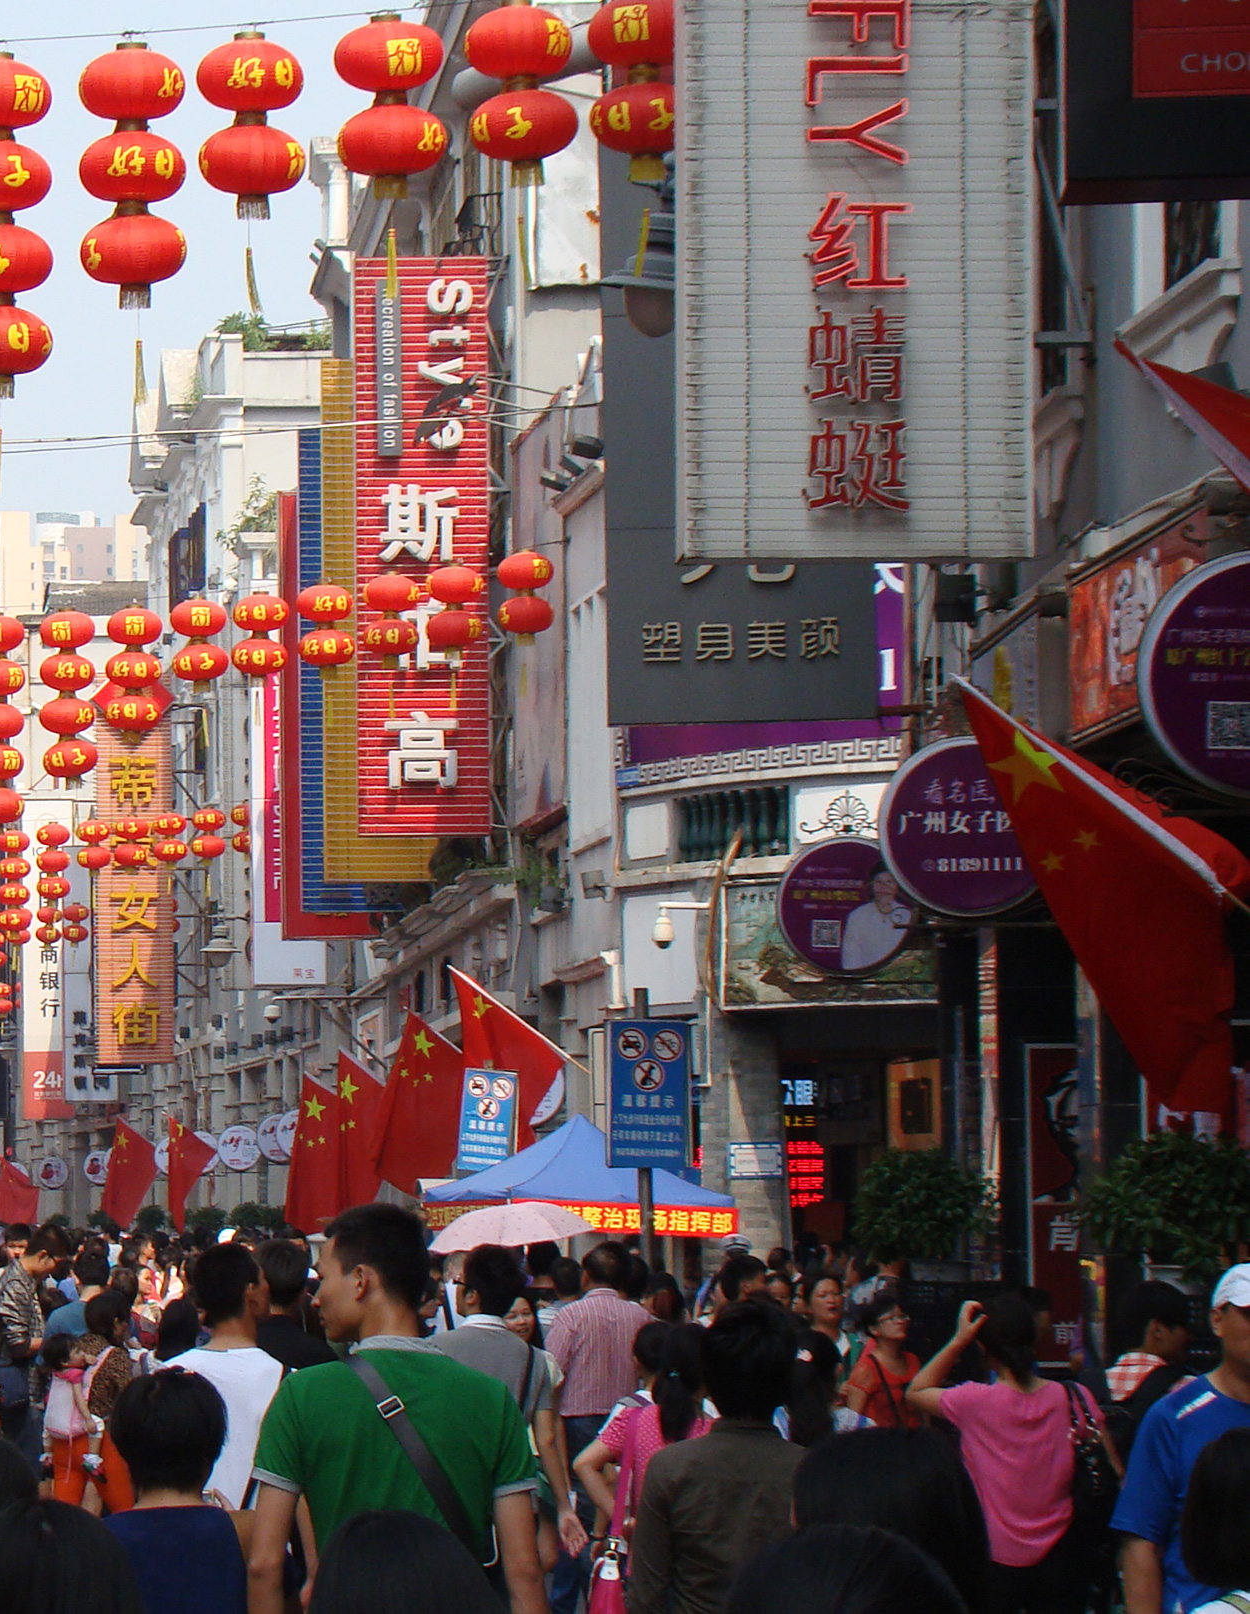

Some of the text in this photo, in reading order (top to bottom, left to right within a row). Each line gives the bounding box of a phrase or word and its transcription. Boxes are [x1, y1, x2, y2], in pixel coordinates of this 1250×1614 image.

[1180, 51, 1250, 74] CHO
[382, 286, 396, 366] ecreation
[417, 278, 474, 450] Stye
[803, 191, 913, 514] 红蜻蜓
[382, 373, 396, 388] of
[641, 615, 841, 663] 塑身美颜
[936, 855, 1024, 873] 81891111
[1048, 1211, 1081, 1252] 肯
